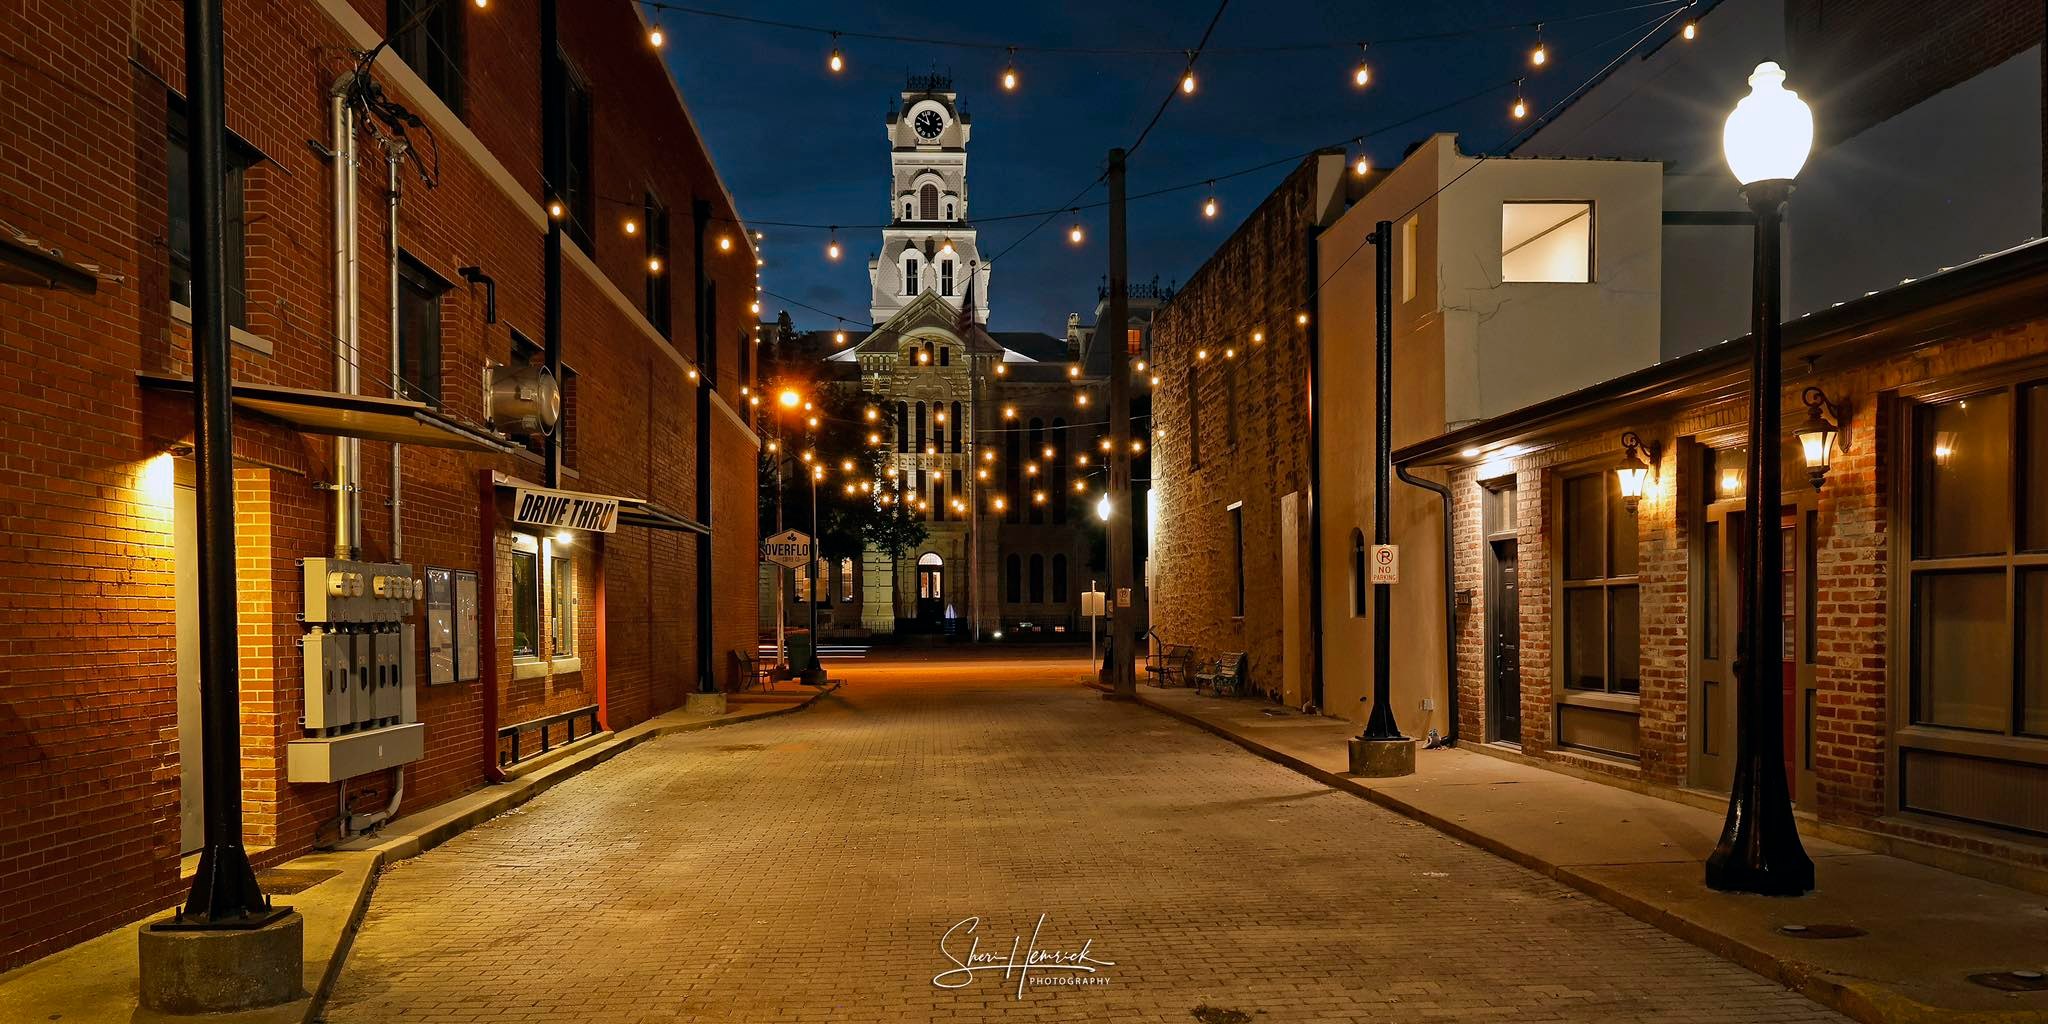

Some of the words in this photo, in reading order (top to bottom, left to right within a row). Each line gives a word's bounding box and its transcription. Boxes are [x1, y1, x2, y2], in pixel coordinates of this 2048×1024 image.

[518, 494, 570, 525] DRIVE
[568, 500, 615, 531] THRU
[765, 543, 818, 556] OVERFLO
[1378, 566, 1391, 574] NO
